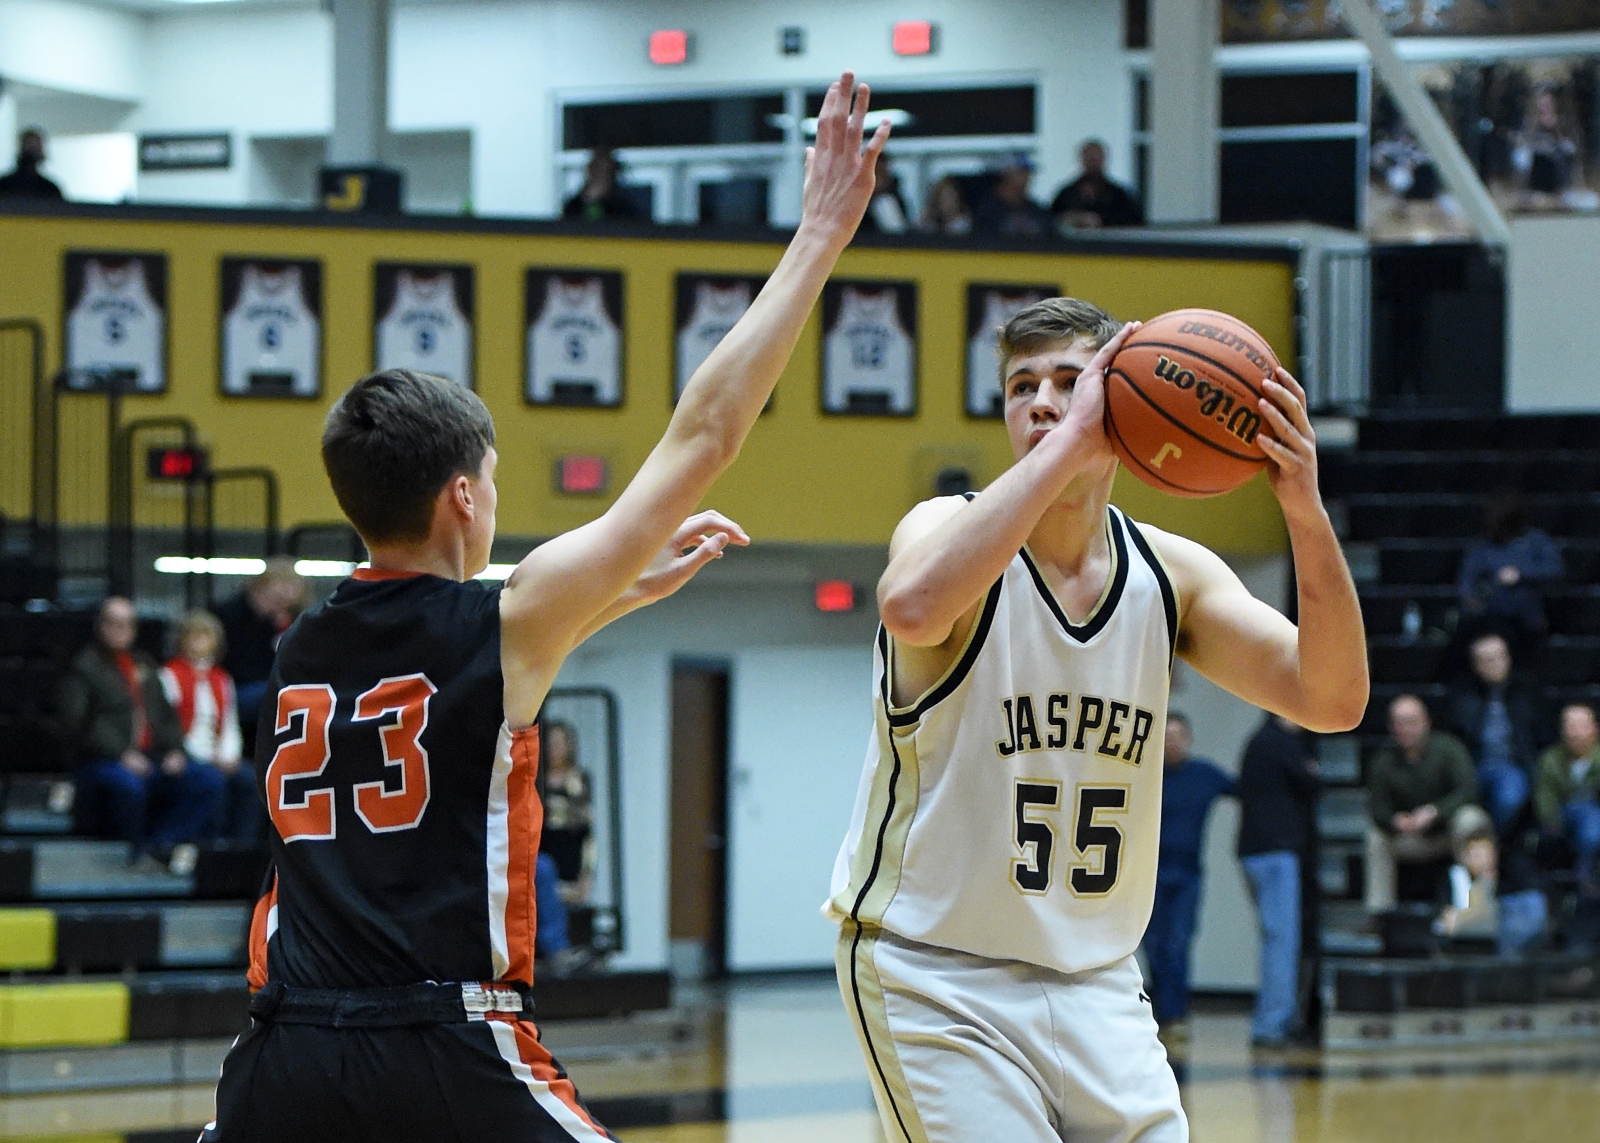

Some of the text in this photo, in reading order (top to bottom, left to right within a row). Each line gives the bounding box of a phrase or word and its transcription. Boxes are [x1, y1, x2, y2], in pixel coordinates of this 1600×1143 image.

[1152, 354, 1262, 447] Wilson
[1149, 442, 1183, 469] J
[266, 672, 438, 845] 23
[995, 692, 1155, 768] JASPER
[1009, 777, 1131, 898] 55
